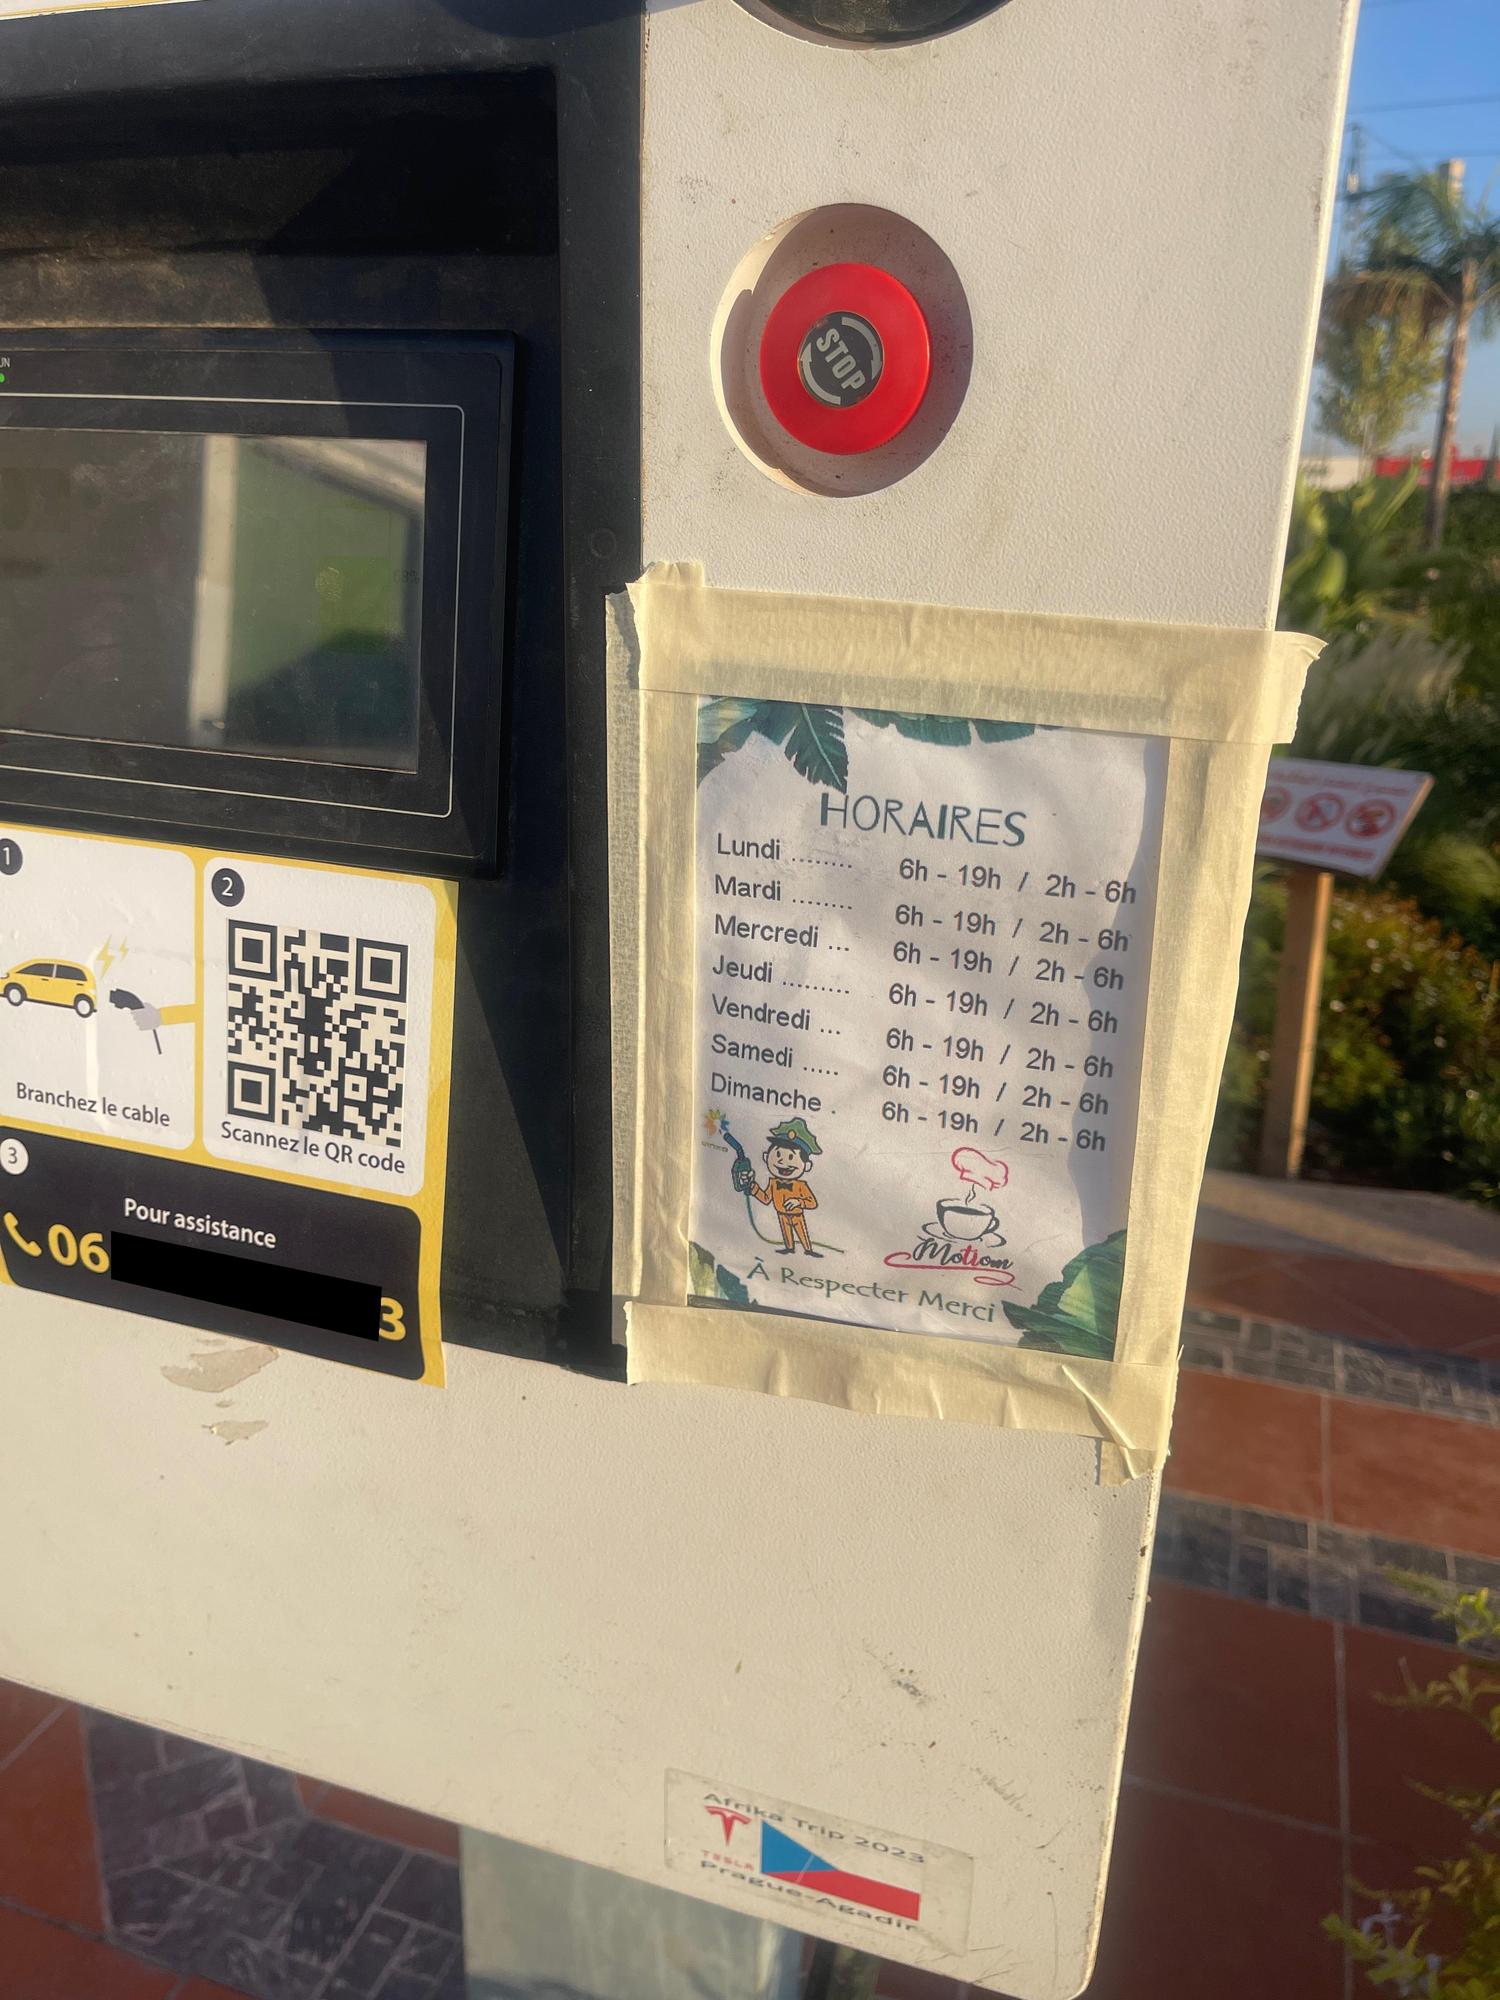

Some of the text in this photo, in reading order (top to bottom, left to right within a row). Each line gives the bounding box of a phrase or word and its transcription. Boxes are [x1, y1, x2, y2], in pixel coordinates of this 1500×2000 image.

[816, 328, 866, 390] STOP
[820, 792, 1027, 847] HORAIRES
[3, 847, 10, 865] 1
[221, 877, 234, 897] 2
[717, 833, 781, 861] Lundi
[899, 857, 929, 883] 6h
[958, 864, 1002, 892] 19h
[1017, 871, 1030, 893] /
[1045, 873, 1076, 899] 2h
[1105, 879, 1137, 904] 6h
[715, 874, 781, 902] Mardi
[895, 903, 924, 928] 6h
[954, 910, 996, 937] 19h
[1012, 917, 1023, 939] /
[1039, 920, 1069, 946] 2h
[1098, 928, 1129, 952] 6h
[715, 913, 818, 948] Mercredi
[893, 941, 921, 965] 6h
[951, 947, 993, 974] 19h
[1008, 955, 1019, 977] /
[1035, 957, 1066, 984] 2h
[1094, 966, 1124, 991] 6h
[712, 954, 773, 983] Jeudi
[888, 982, 917, 1008] 6h
[947, 989, 988, 1017] 19h
[1003, 997, 1015, 1020] /
[1030, 1000, 1060, 1027] 2h
[1088, 1009, 1118, 1034] 6h
[712, 993, 811, 1031] Vendredi
[886, 1027, 914, 1052] 6h
[943, 1034, 984, 1063] 19h
[999, 1043, 1011, 1066] /
[1026, 1046, 1056, 1073] 2h
[1084, 1055, 1114, 1078] 6h
[17, 1082, 170, 1127] Branchez le cable
[711, 1033, 793, 1068] Samedi
[882, 1064, 911, 1090] 6h
[939, 1072, 981, 1101] 19h
[996, 1081, 1007, 1103] /
[1022, 1084, 1052, 1110] 2h
[1079, 1092, 1109, 1115] 6h
[711, 1071, 822, 1113] Dimanche
[881, 1100, 910, 1124] 6h
[938, 1109, 979, 1134] 19h
[994, 1118, 1005, 1138] /
[1020, 1121, 1049, 1145] 2h
[1076, 1128, 1106, 1152] 6h
[8, 1147, 18, 1164] 3
[221, 1121, 405, 1174] Scannez le QR code
[124, 1197, 276, 1249] Pour assistance
[747, 1256, 996, 1324] À Respecter Merci
[704, 1793, 925, 1864] Afrika Trip 2023
[700, 1860, 918, 1931] Prague-Agadir
